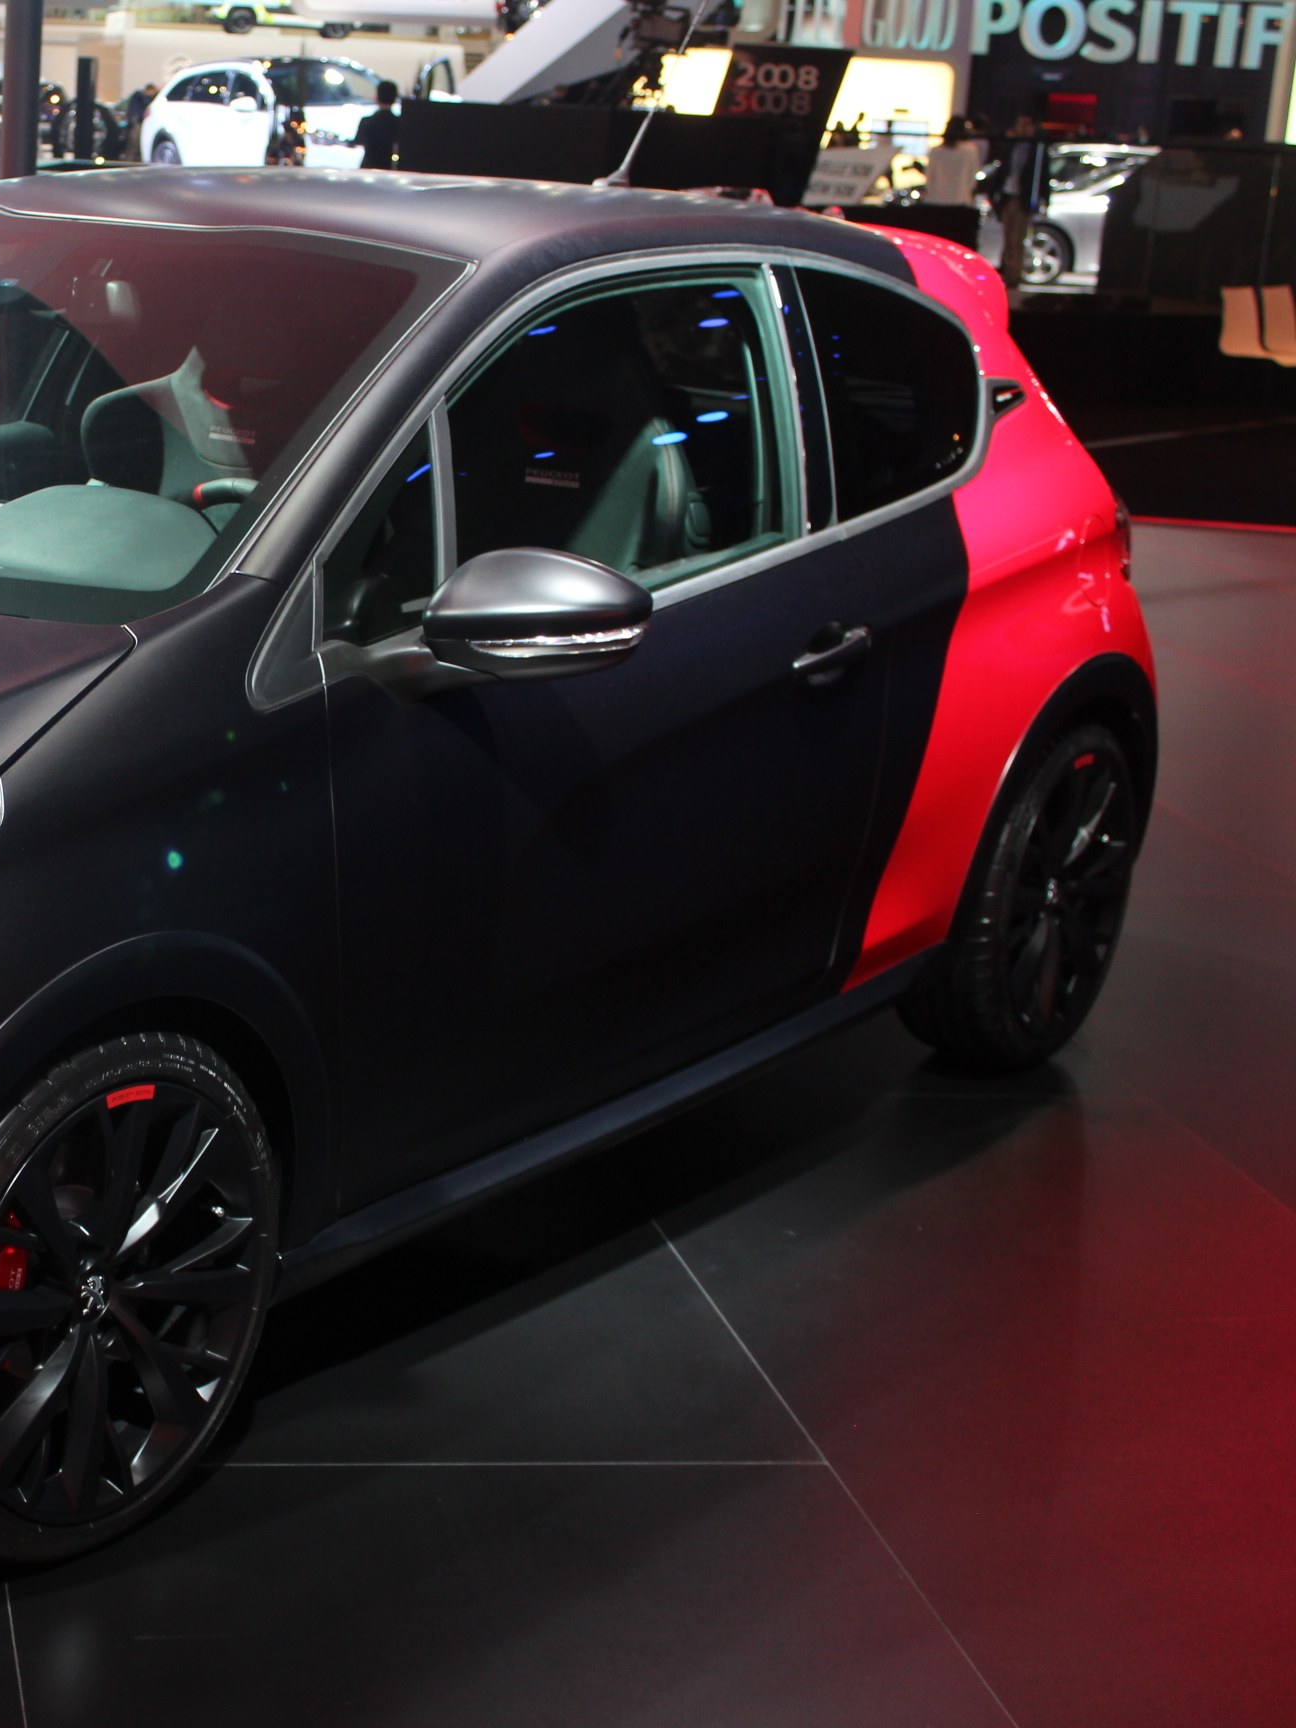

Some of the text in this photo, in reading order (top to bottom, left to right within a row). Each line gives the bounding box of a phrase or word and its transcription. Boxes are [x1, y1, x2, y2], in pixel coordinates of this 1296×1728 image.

[971, 0, 1284, 69] POSITIF
[735, 60, 819, 91] 2008
[729, 89, 812, 115] 3008
